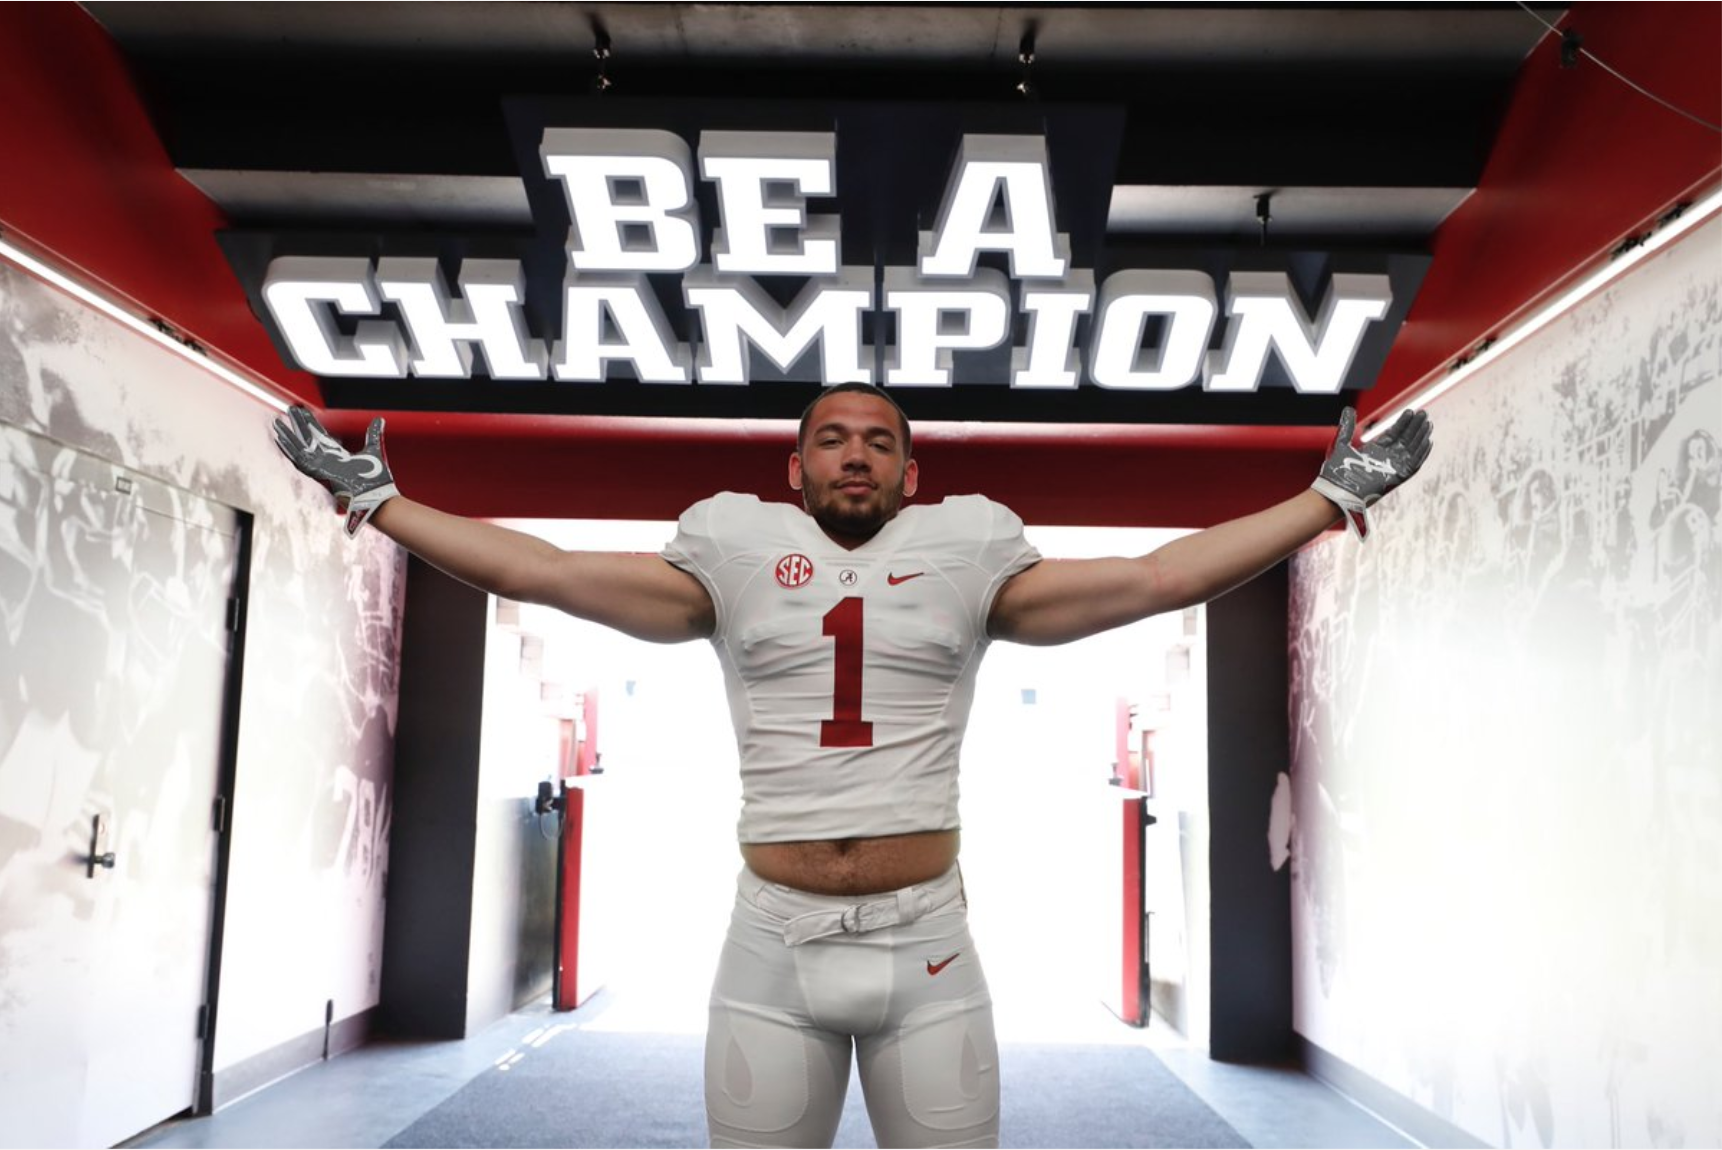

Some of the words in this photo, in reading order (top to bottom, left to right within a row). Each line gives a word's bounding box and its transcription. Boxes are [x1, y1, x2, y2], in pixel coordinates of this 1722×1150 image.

[544, 152, 841, 276] BE
[918, 160, 1070, 281] A
[261, 278, 1391, 395] CHAMPION
[778, 555, 811, 586] SEC
[820, 596, 873, 747] 1
